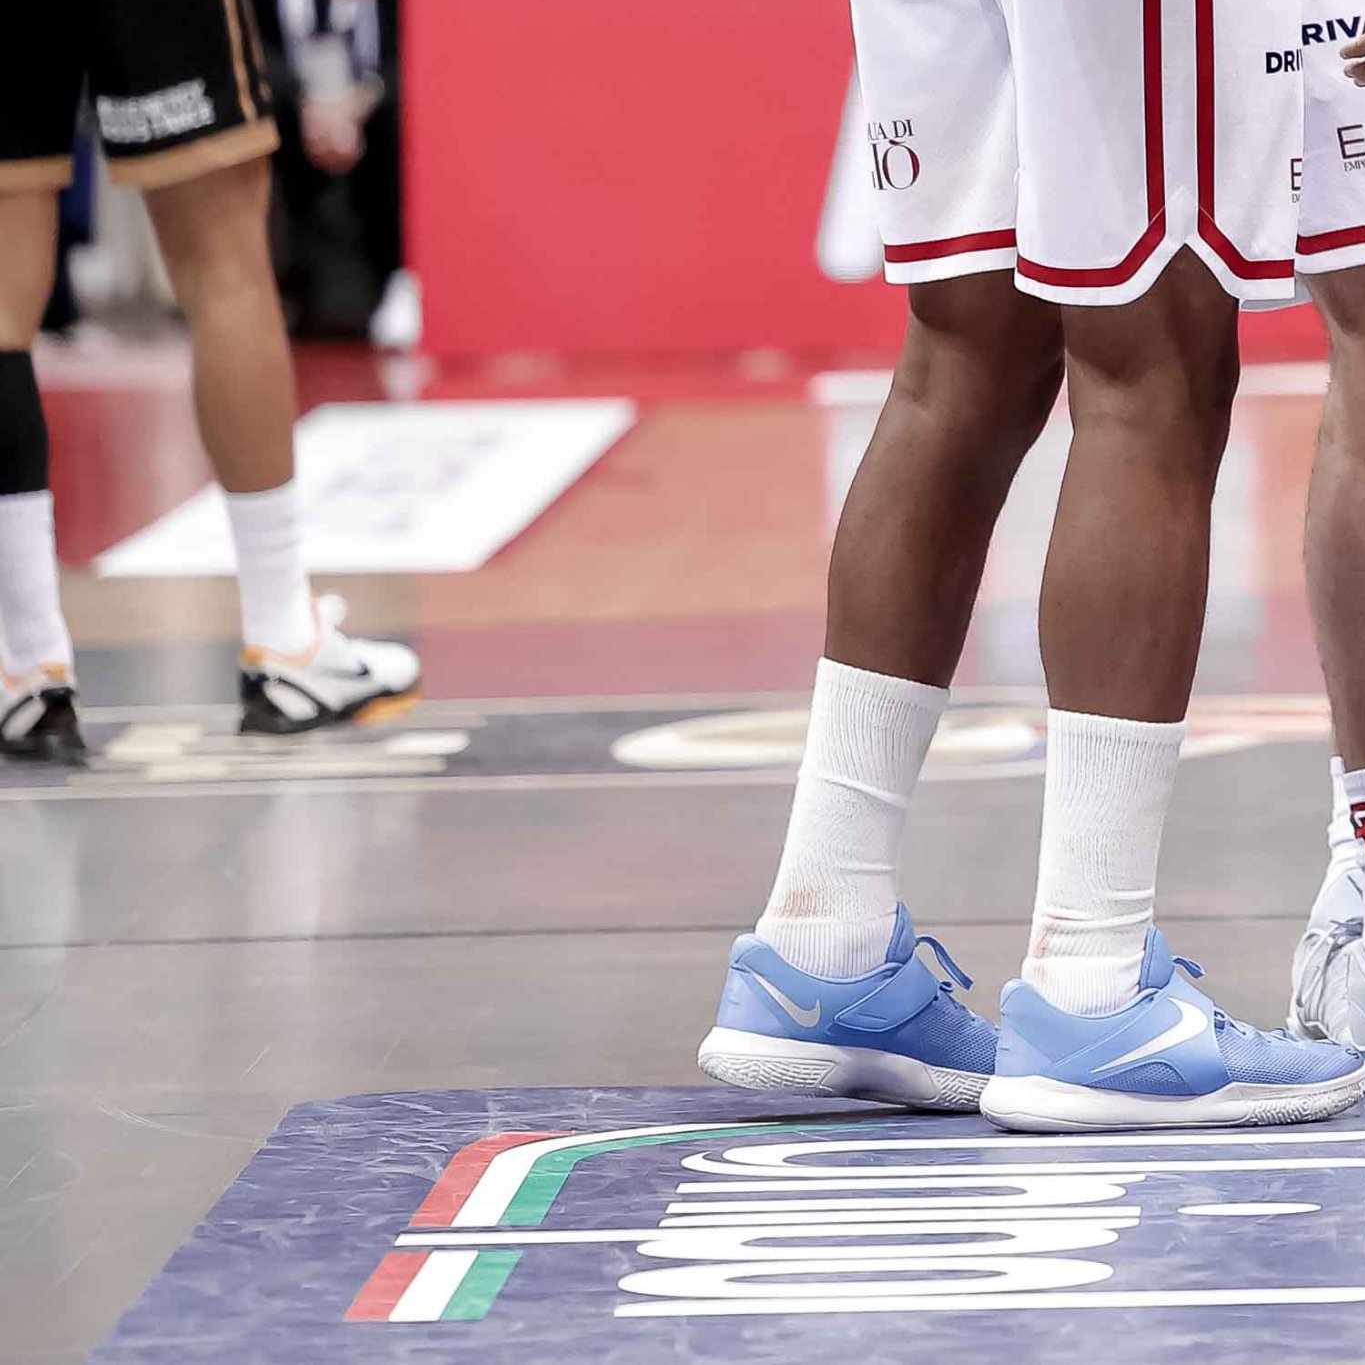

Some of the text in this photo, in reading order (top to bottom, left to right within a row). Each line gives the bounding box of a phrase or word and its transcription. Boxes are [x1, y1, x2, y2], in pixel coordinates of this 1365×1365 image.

[1265, 49, 1303, 74] DRI
[892, 119, 915, 138] DI
[871, 139, 920, 191] IÒ
